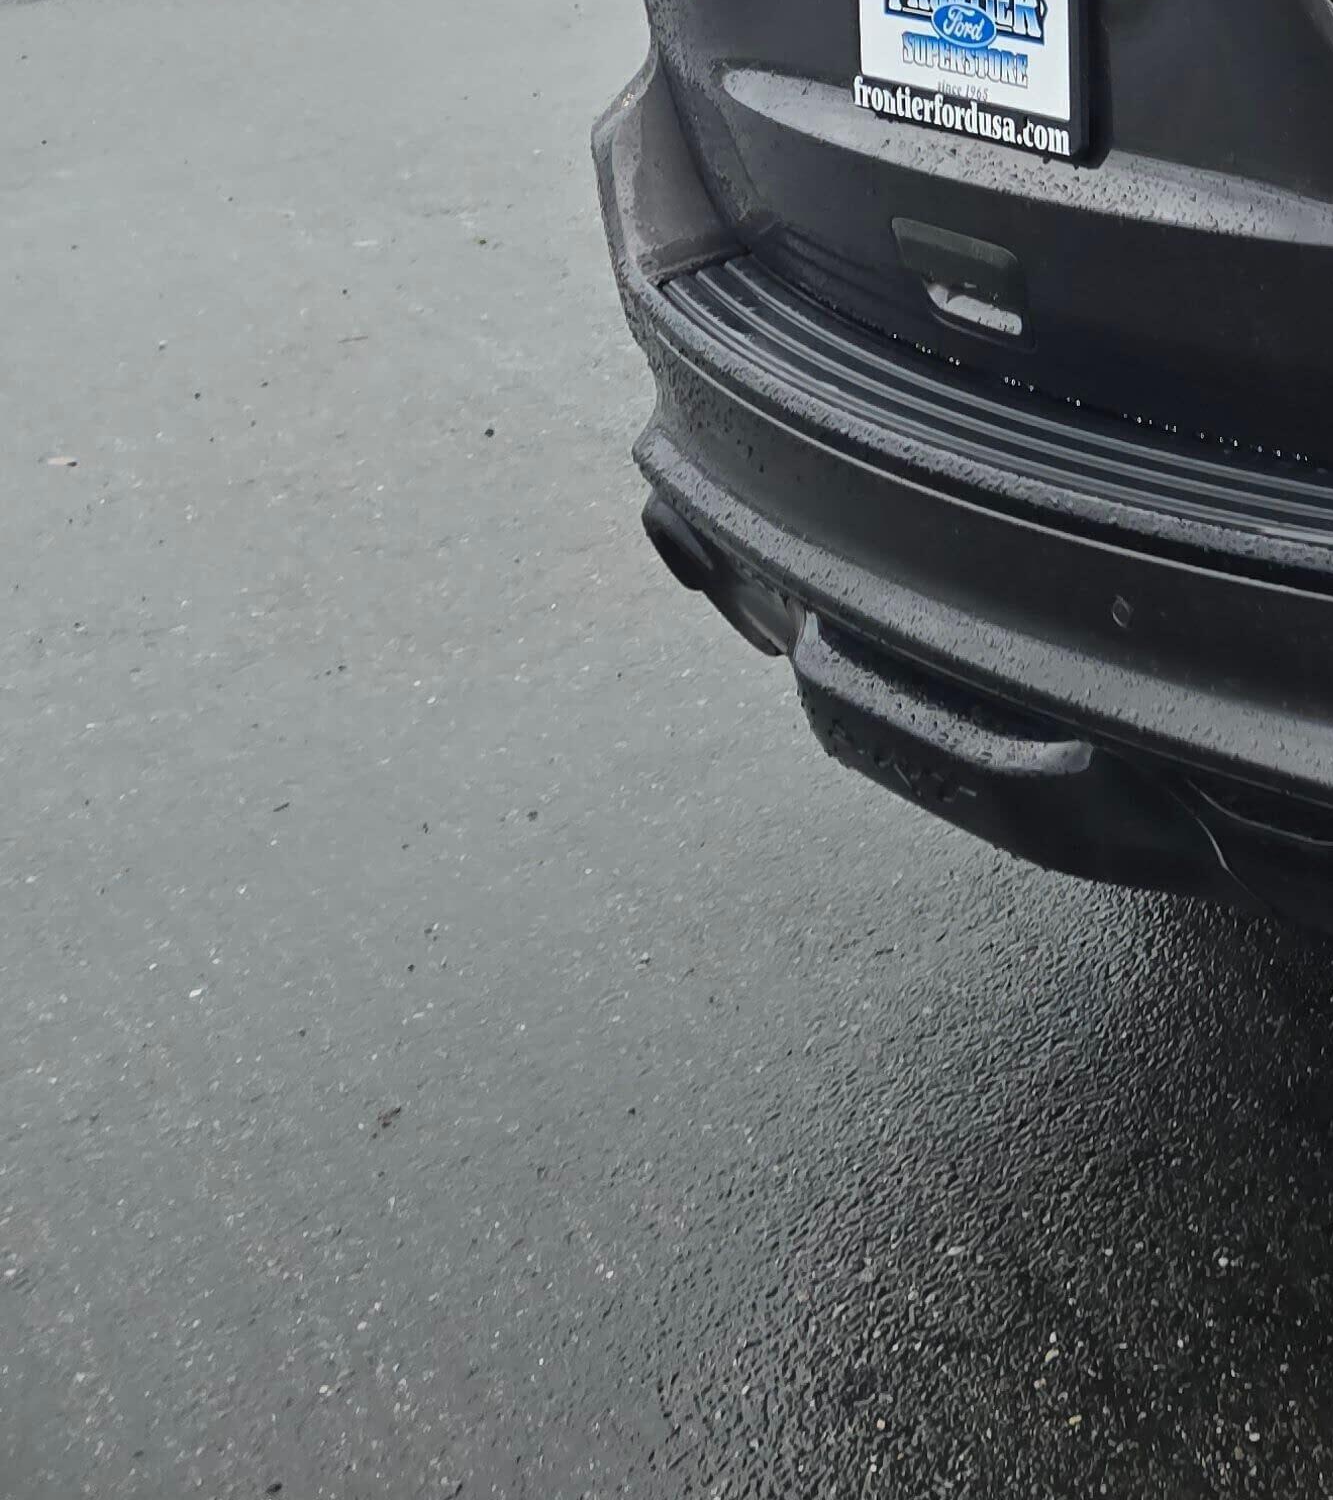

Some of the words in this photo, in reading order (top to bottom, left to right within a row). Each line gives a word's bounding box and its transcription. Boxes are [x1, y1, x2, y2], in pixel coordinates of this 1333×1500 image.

[943, 6, 985, 41] Ford
[902, 32, 1029, 89] SUPERSTORE
[853, 76, 1071, 156] frontierfordusa.com
